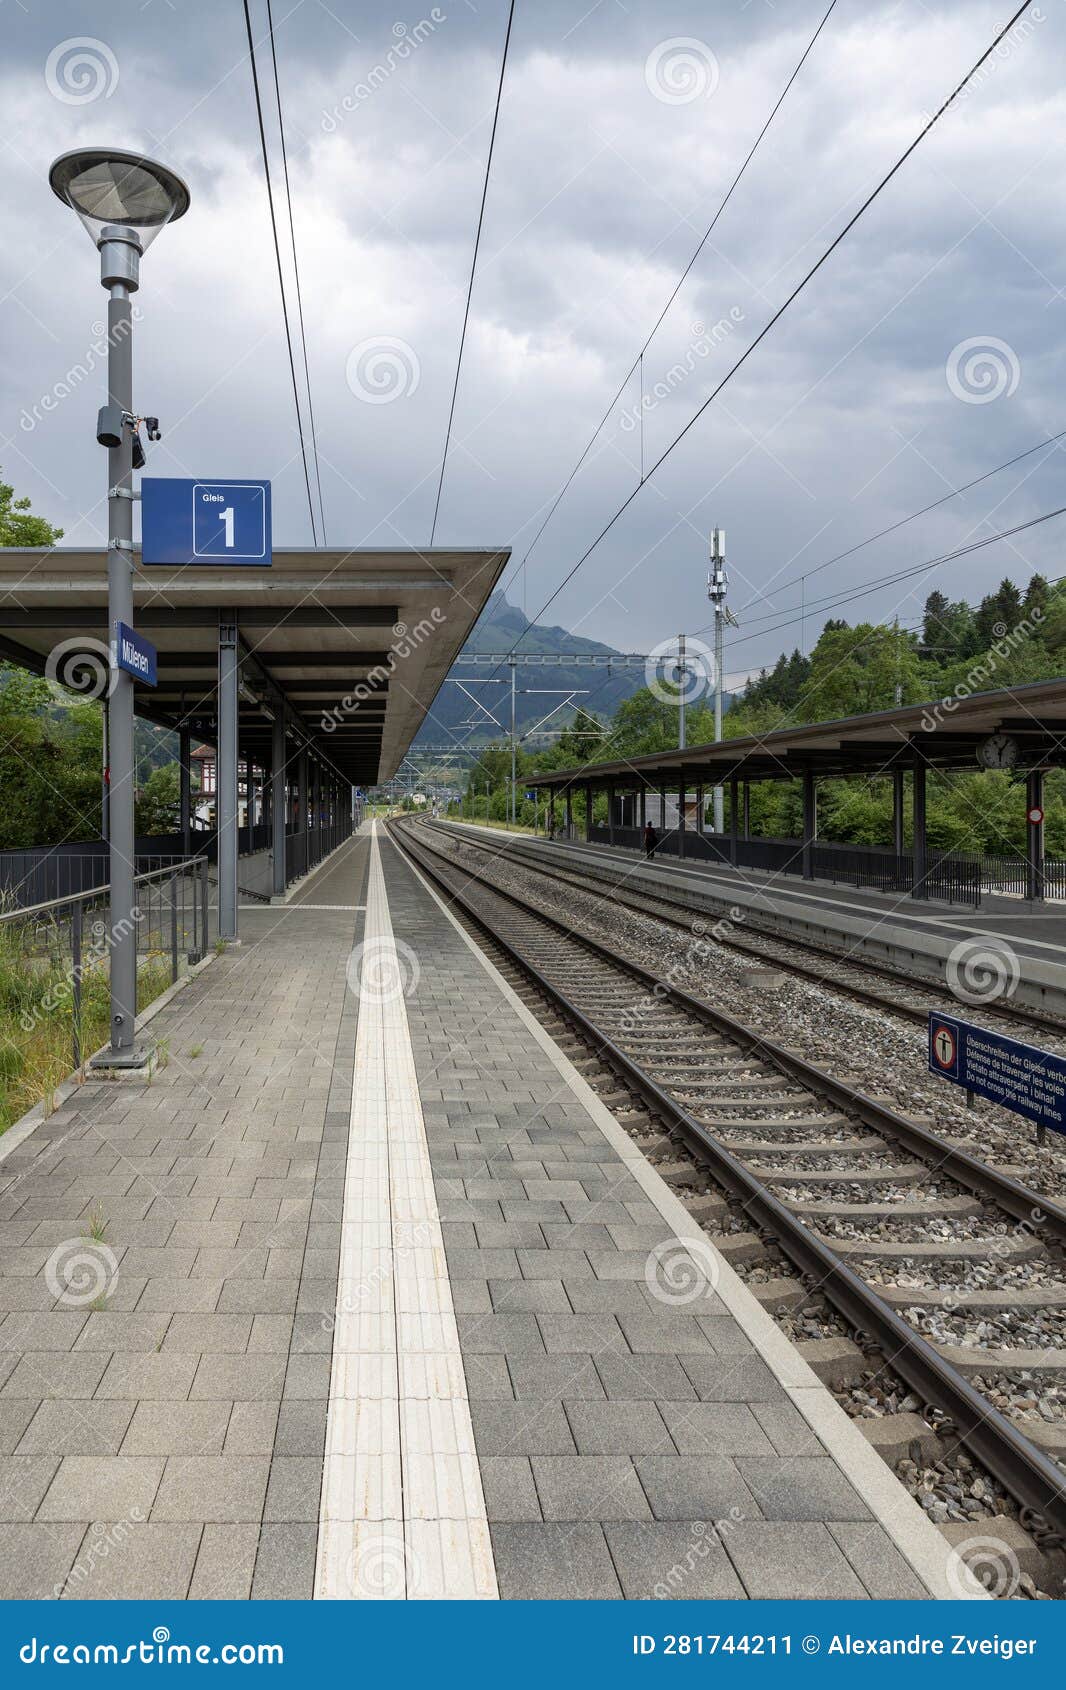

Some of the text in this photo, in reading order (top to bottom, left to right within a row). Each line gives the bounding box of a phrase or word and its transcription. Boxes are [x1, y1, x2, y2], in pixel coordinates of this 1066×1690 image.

[202, 494, 225, 502] Gleis
[218, 507, 235, 547] 1
[122, 638, 149, 674] Mülenen
[966, 1058, 988, 1076] Vietato
[988, 1070, 1029, 1094] attraversare
[1034, 1087, 1056, 1106] binari
[991, 1059, 1001, 1070] de
[1001, 1061, 1031, 1082] traverser
[1032, 1073, 1044, 1088] les
[1045, 1081, 1065, 1097] voies
[1010, 1054, 1022, 1066] der
[1023, 1058, 1046, 1076] Gleise
[966, 1070, 1062, 1121] Do not cross the railway lines
